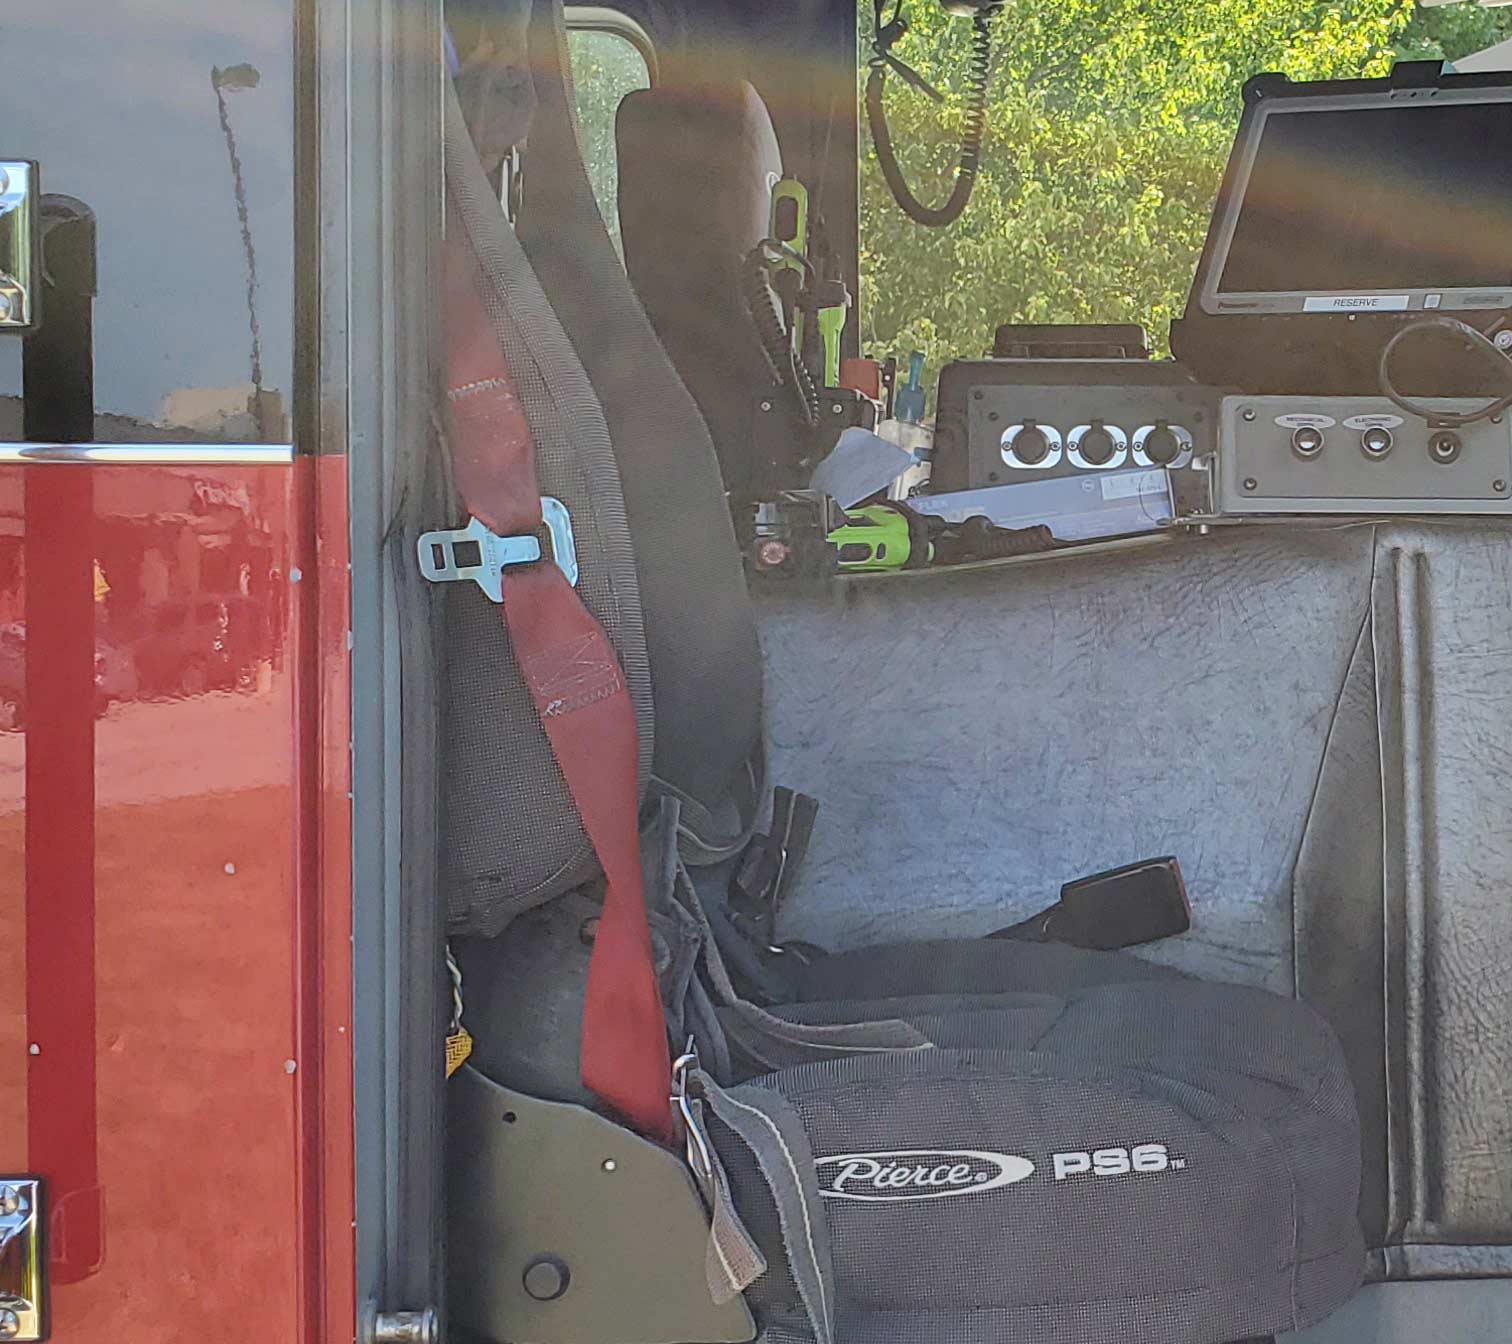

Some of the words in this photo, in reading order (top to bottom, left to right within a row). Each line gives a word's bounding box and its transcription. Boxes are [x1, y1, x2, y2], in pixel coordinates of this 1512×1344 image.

[1333, 298, 1379, 307] RESERVE
[833, 1158, 972, 1192] Pierce
[1052, 1144, 1168, 1180] PS6
